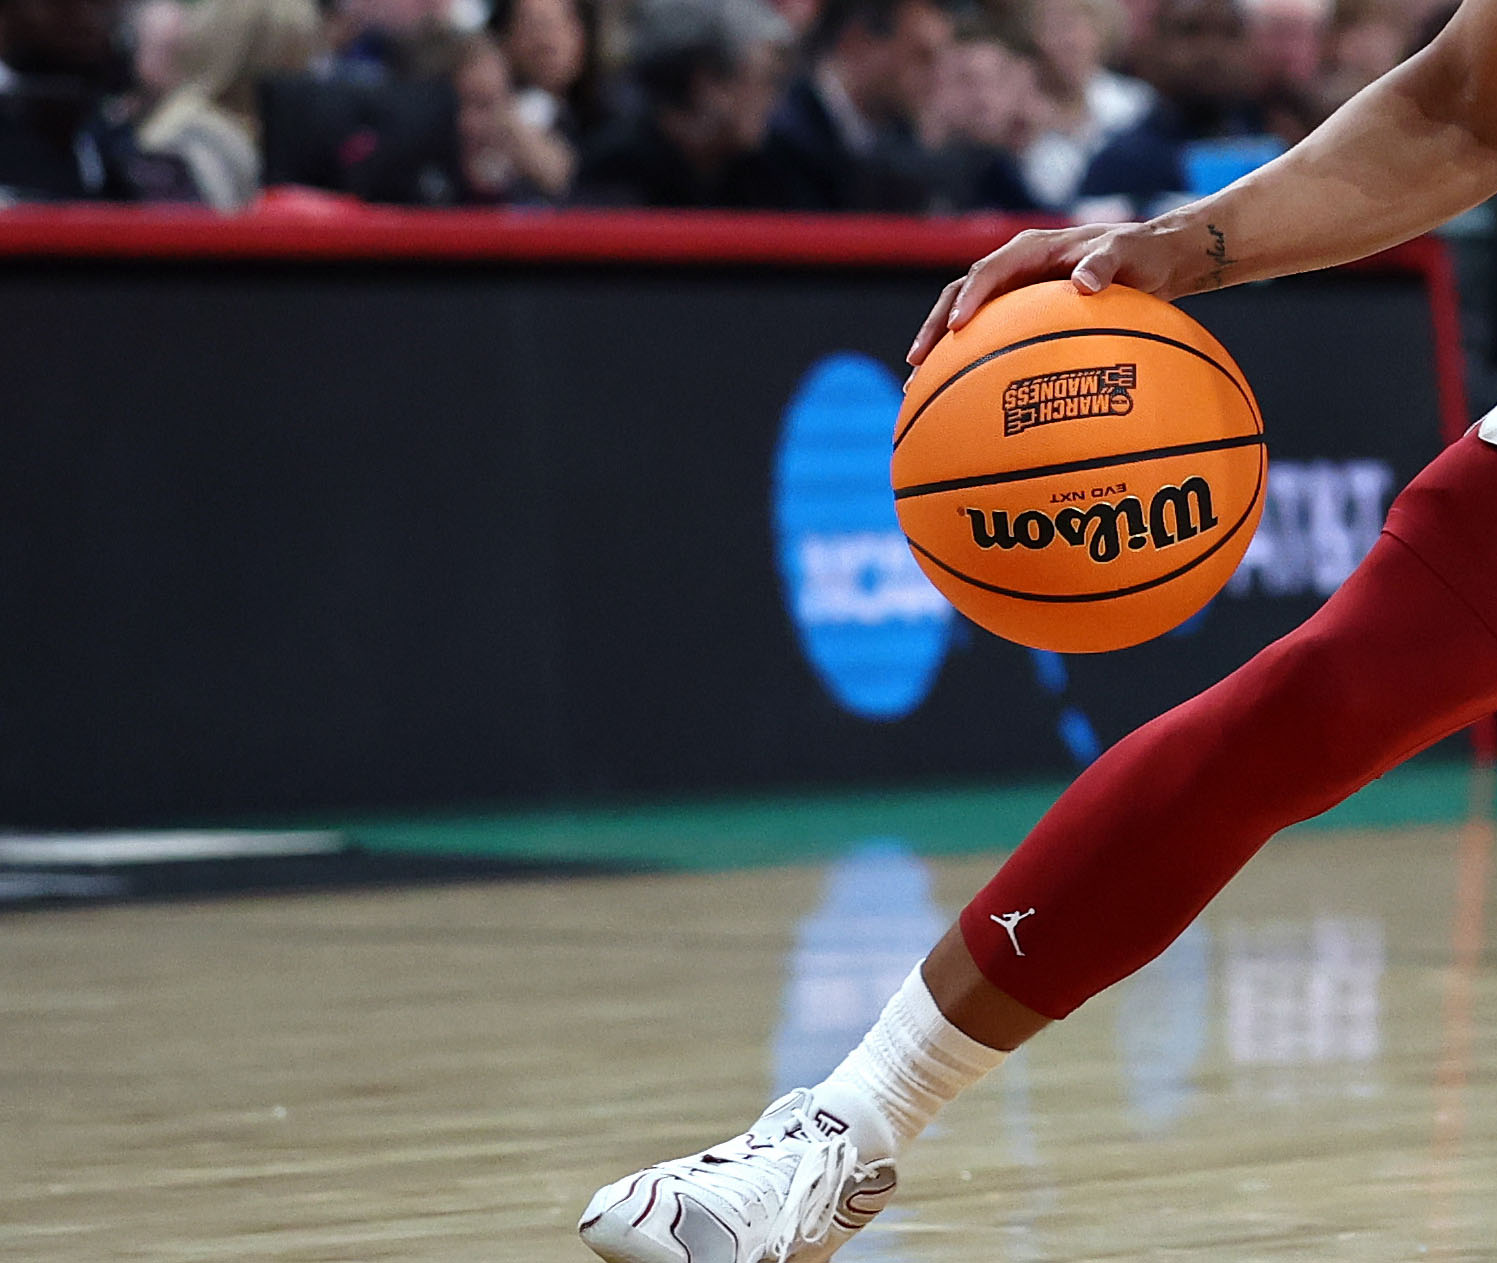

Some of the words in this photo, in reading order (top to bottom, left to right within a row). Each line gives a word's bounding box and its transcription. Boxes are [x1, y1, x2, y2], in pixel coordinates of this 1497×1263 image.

[1004, 375, 1098, 410] MADNESS
[1039, 394, 1110, 422] MARCH
[1049, 490, 1086, 504] NXT
[1090, 482, 1127, 499] EVO
[965, 474, 1219, 565] Wilson
